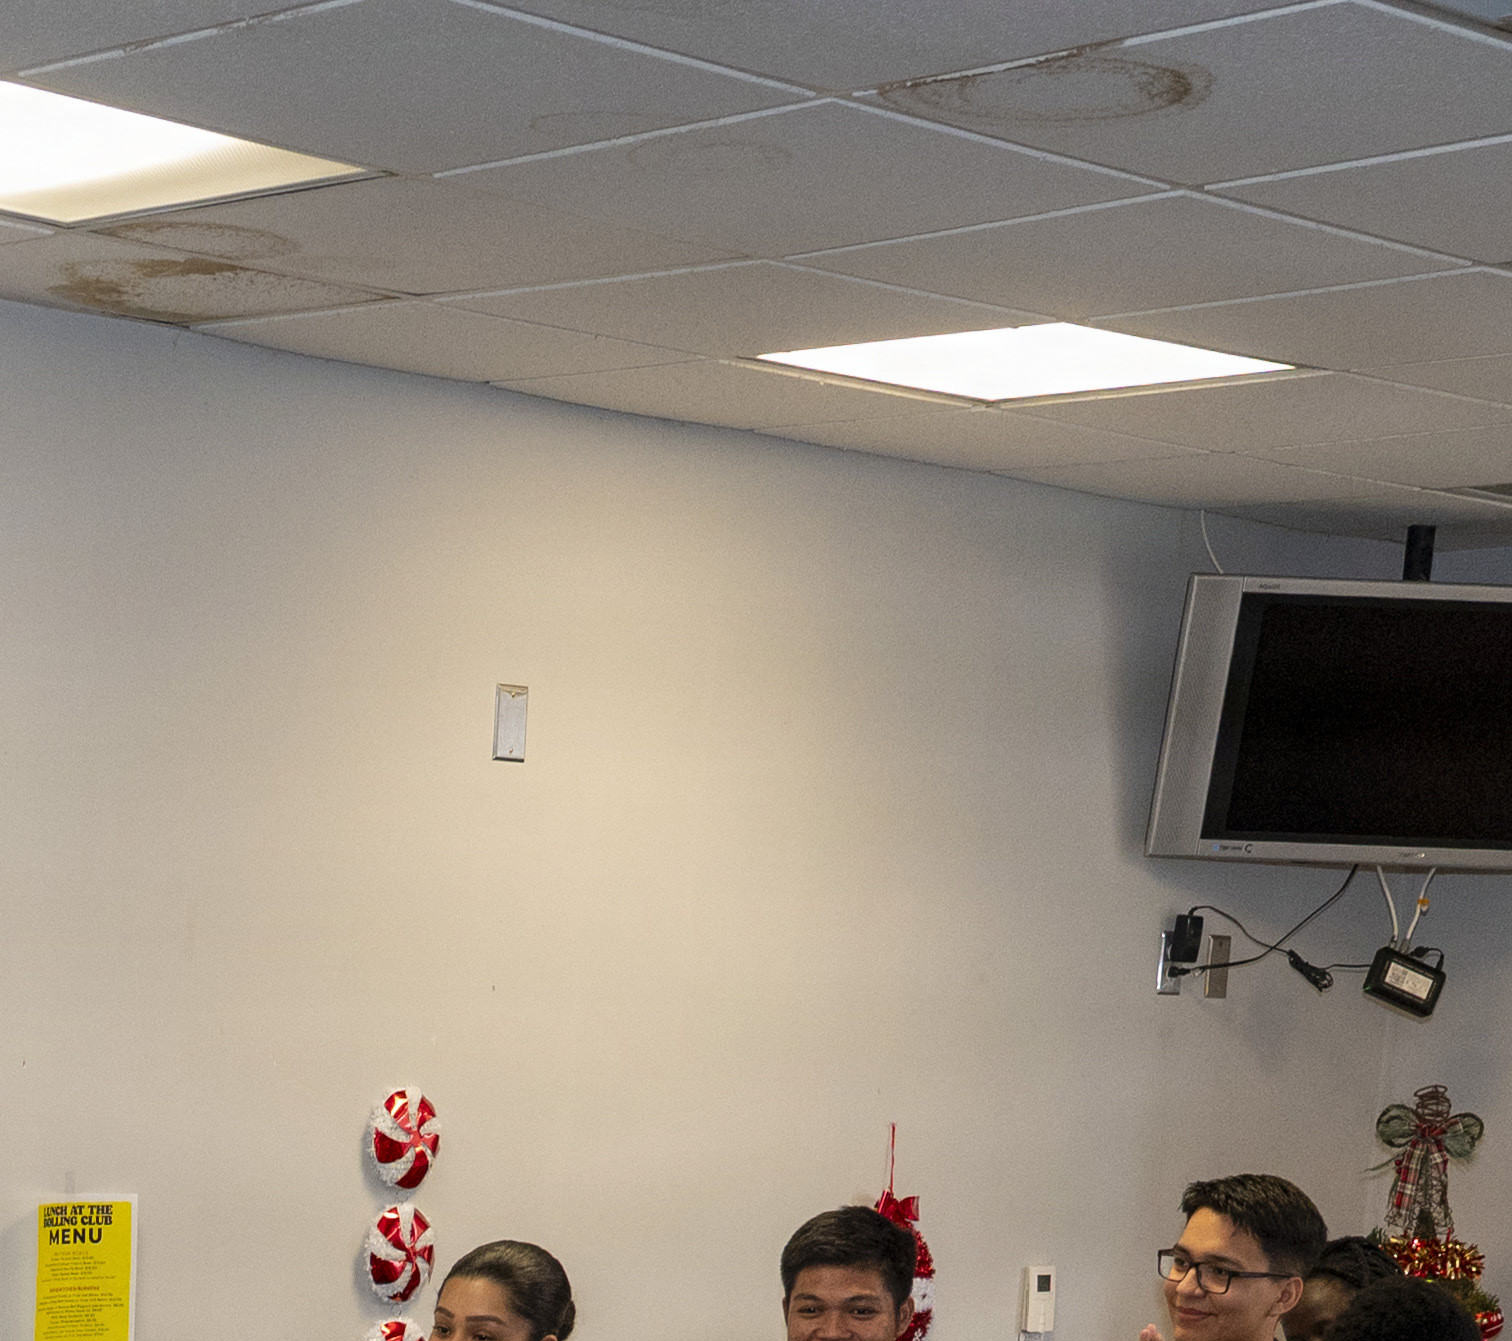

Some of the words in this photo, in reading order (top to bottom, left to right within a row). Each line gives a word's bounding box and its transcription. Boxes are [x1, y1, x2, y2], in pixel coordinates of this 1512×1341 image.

[44, 1205, 67, 1217] LUNCH
[70, 1205, 85, 1215] AT
[88, 1204, 113, 1215] THE
[81, 1215, 113, 1226] CLUB
[49, 1228, 102, 1245] MENU
